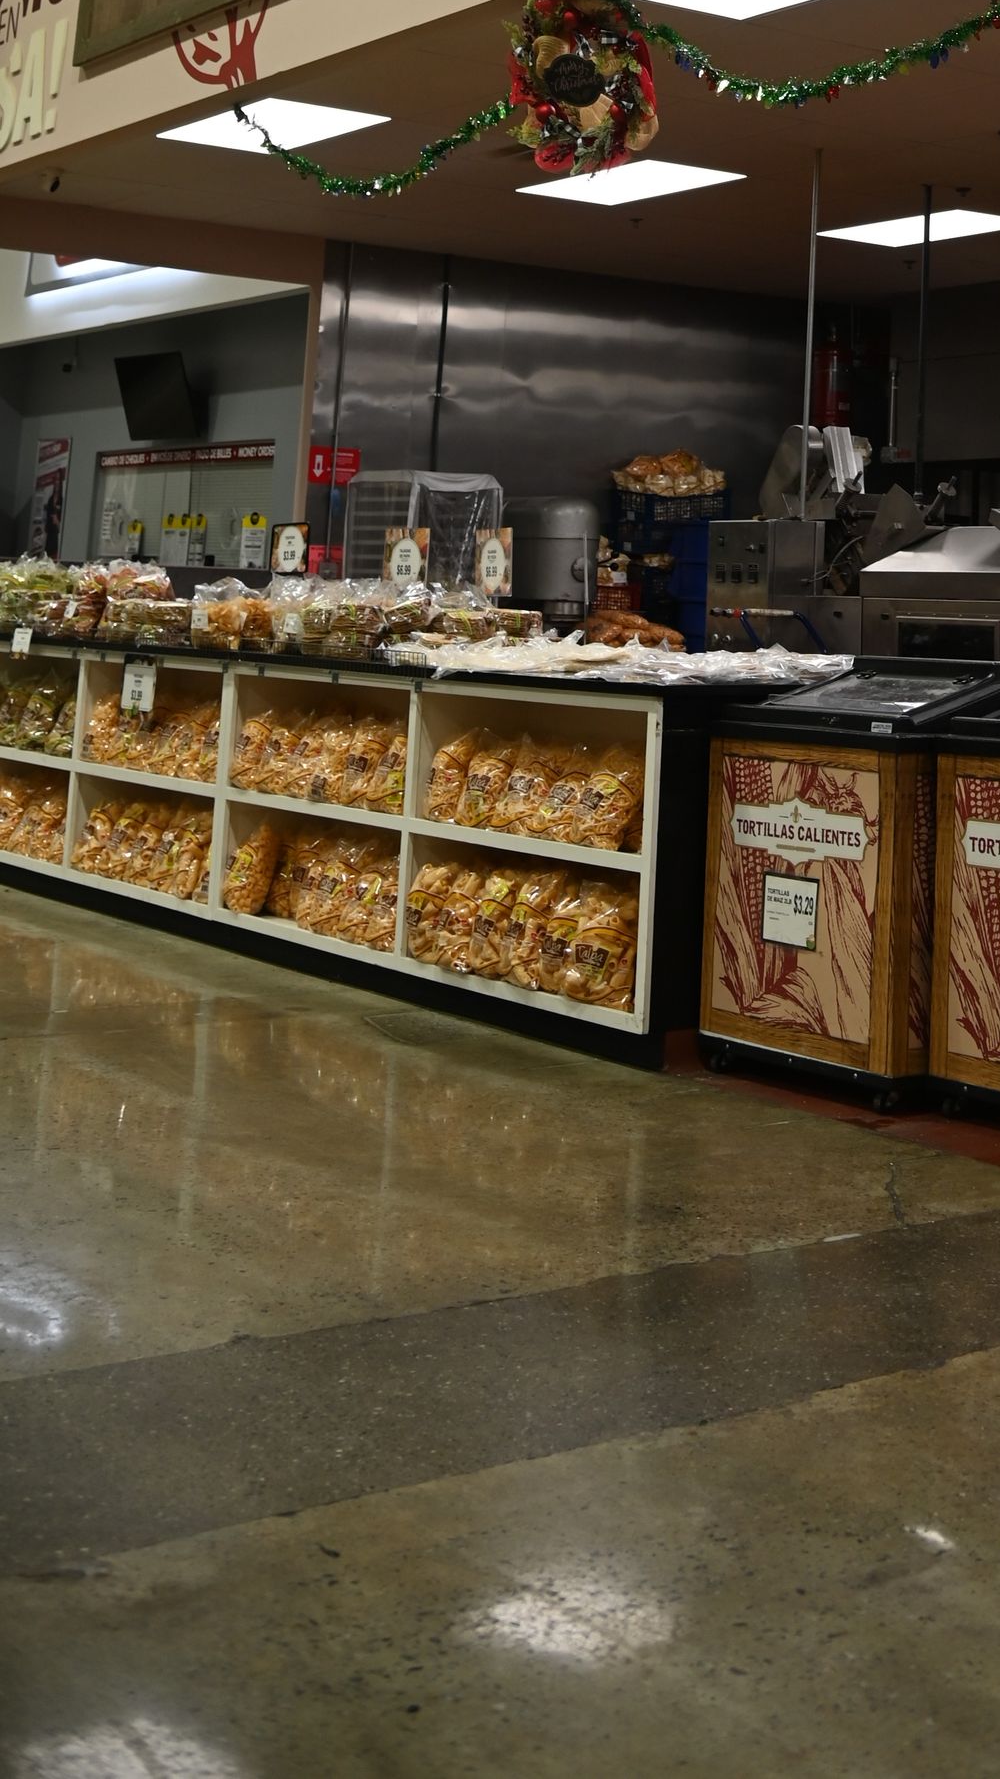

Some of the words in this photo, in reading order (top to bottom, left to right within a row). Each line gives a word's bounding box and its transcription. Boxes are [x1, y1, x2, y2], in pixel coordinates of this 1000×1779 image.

[736, 819, 795, 840] TORTILLAS
[798, 826, 861, 847] CALIENTES
[768, 888, 789, 896] TORTILLAS
[794, 894, 814, 916] $3.29
[576, 945, 604, 963] Talpa
